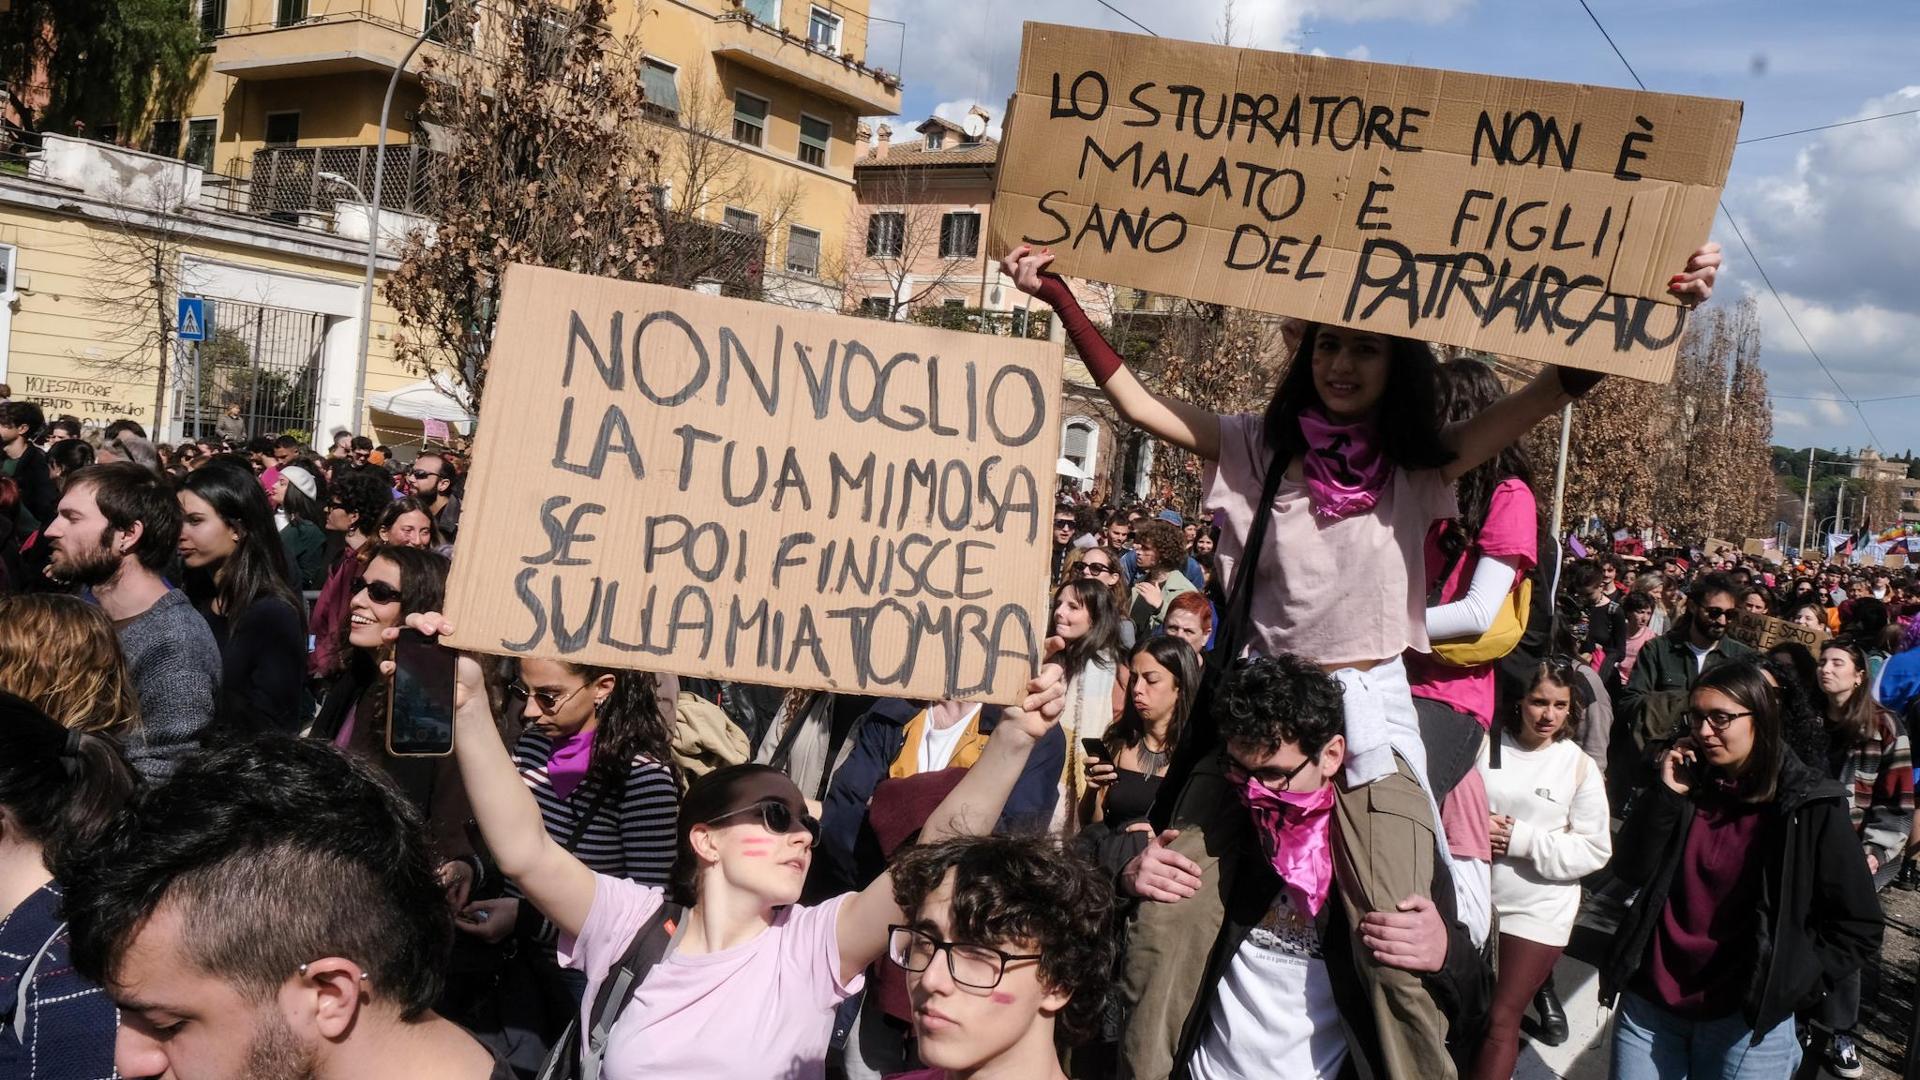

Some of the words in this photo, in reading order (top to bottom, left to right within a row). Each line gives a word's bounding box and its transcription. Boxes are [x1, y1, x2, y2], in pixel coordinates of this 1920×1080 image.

[1050, 70, 1109, 122] LO
[1123, 82, 1431, 154] STUPRATORE
[1471, 109, 1583, 172] NON
[1614, 115, 1655, 182] È
[1021, 190, 1188, 254] SANO
[1223, 223, 1326, 281] DEL
[1078, 135, 1306, 223] MALATO
[1357, 166, 1394, 231] È
[1449, 189, 1616, 259] FIGLI
[26, 376, 112, 397] MOLESTATORE
[561, 308, 784, 417] NON
[793, 337, 1046, 448] VOGLIO
[551, 396, 645, 481] LA
[673, 424, 814, 512] TUA
[827, 451, 1041, 547] MIMOSA
[520, 495, 607, 567] SE
[644, 513, 748, 584] POI
[772, 532, 997, 601] FINISCE
[500, 567, 715, 662] SULLA
[725, 594, 831, 678] MIA
[824, 598, 1040, 700] TOMBA
[1779, 623, 1816, 644] STATO
